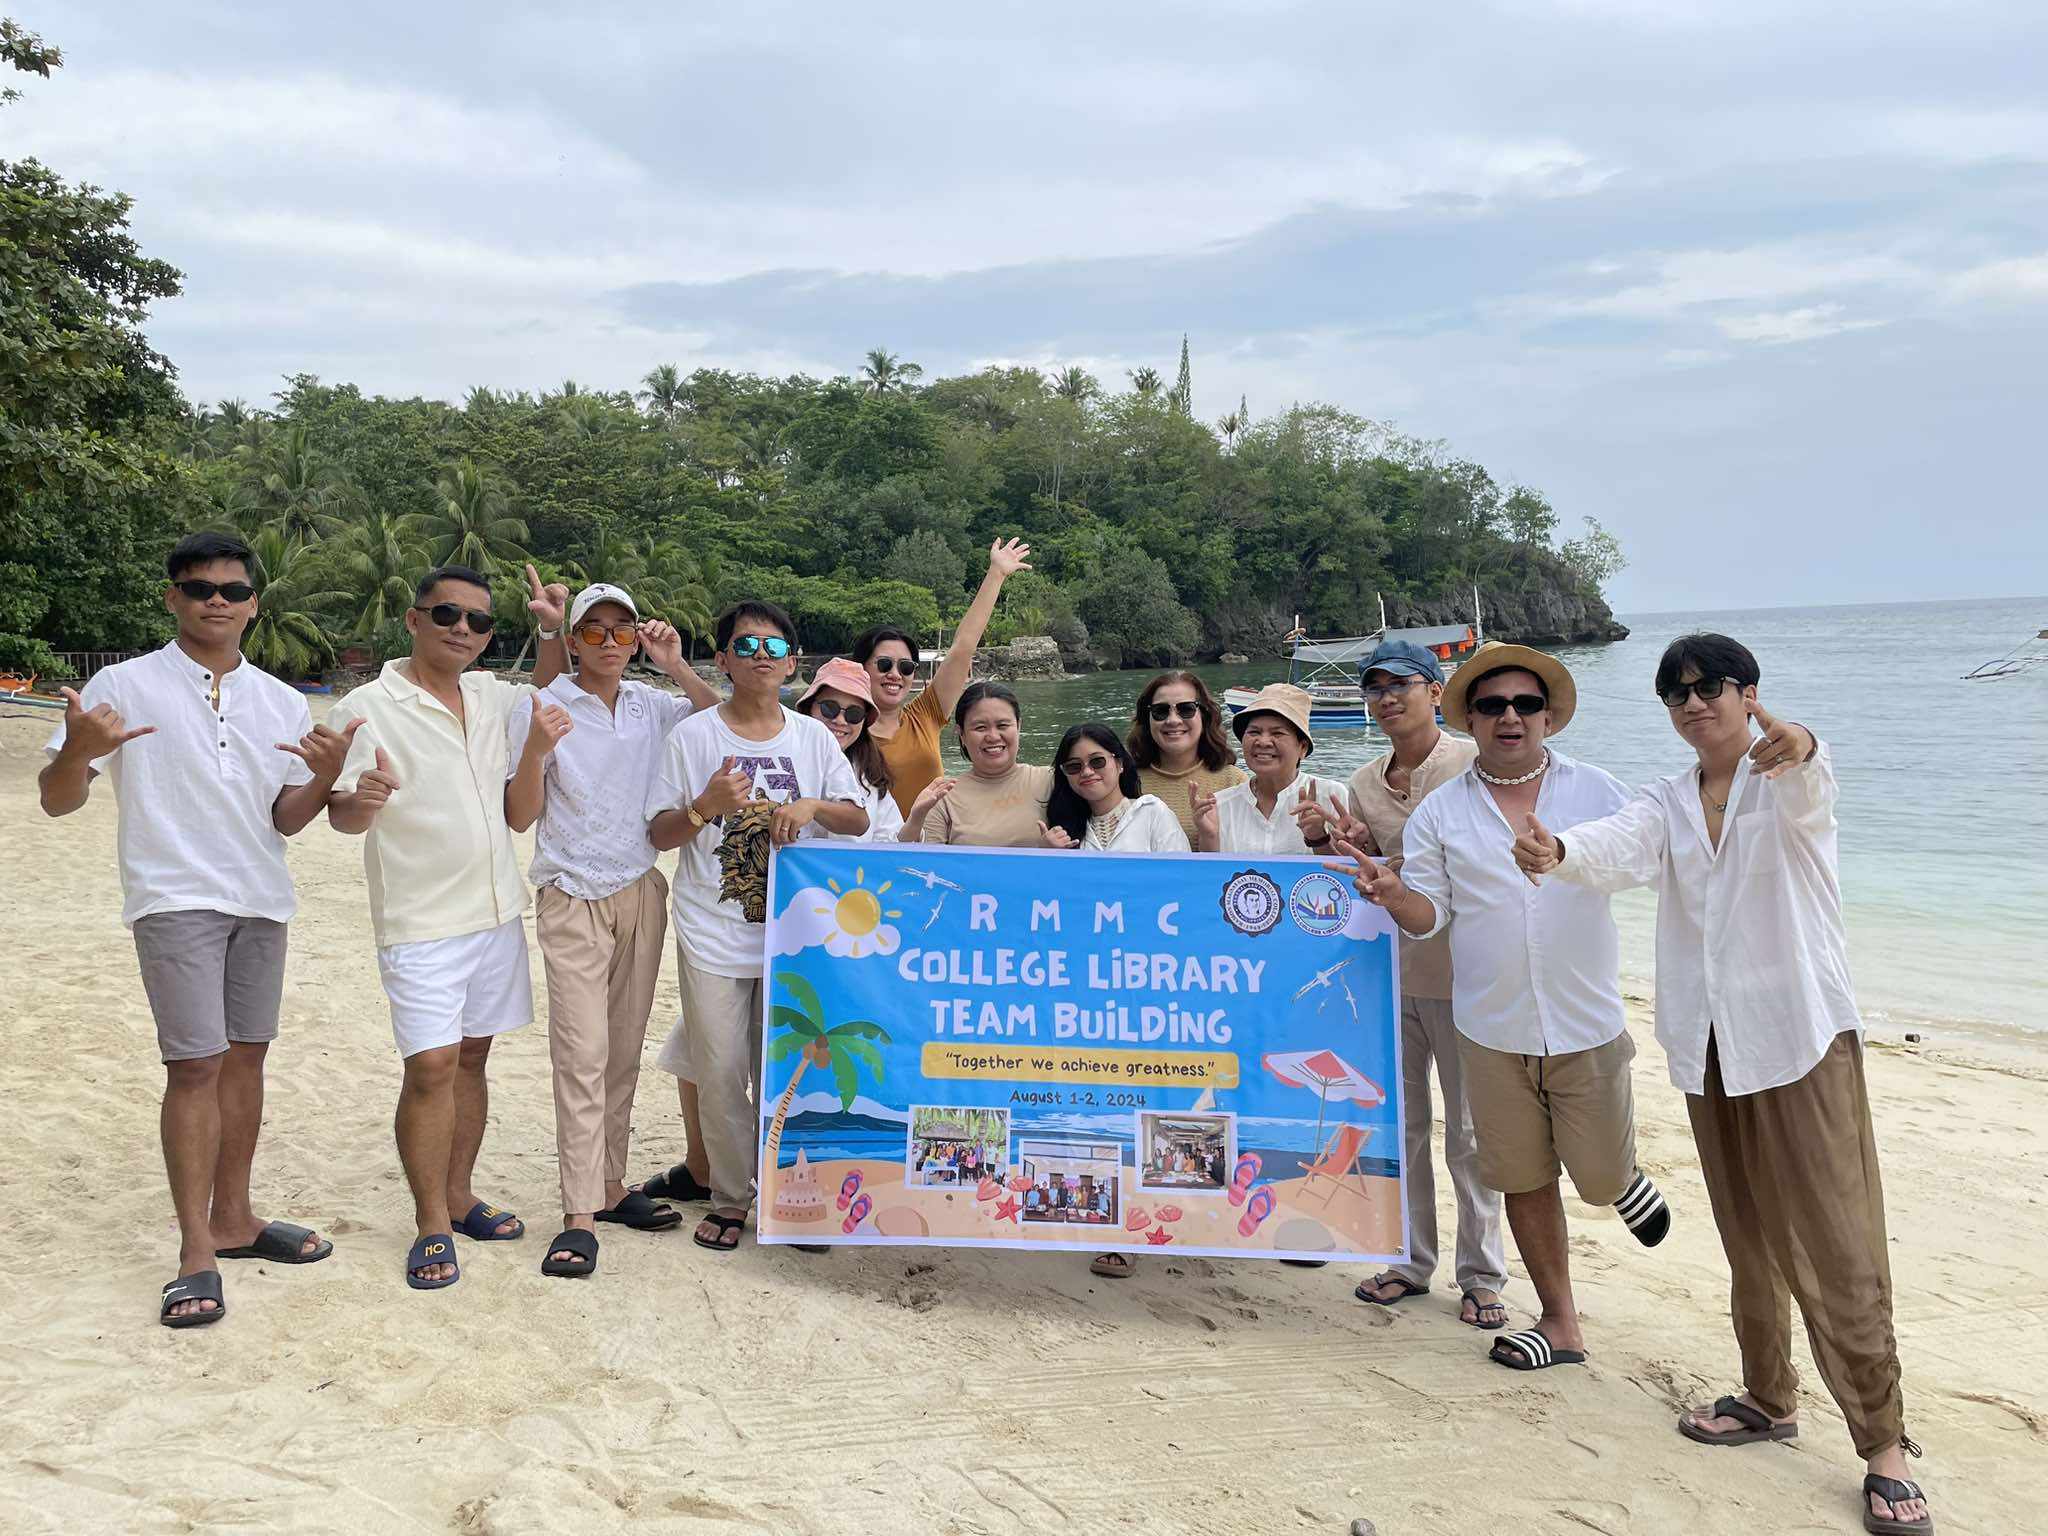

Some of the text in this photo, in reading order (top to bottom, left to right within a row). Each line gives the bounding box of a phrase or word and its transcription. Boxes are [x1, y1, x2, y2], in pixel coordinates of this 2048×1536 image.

[899, 948, 1071, 987] COLLEGE
[930, 998, 1037, 1036] TEAM
[1060, 1057, 1119, 1074] achieve
[1009, 1090, 1147, 1107] August 1-2, 2024
